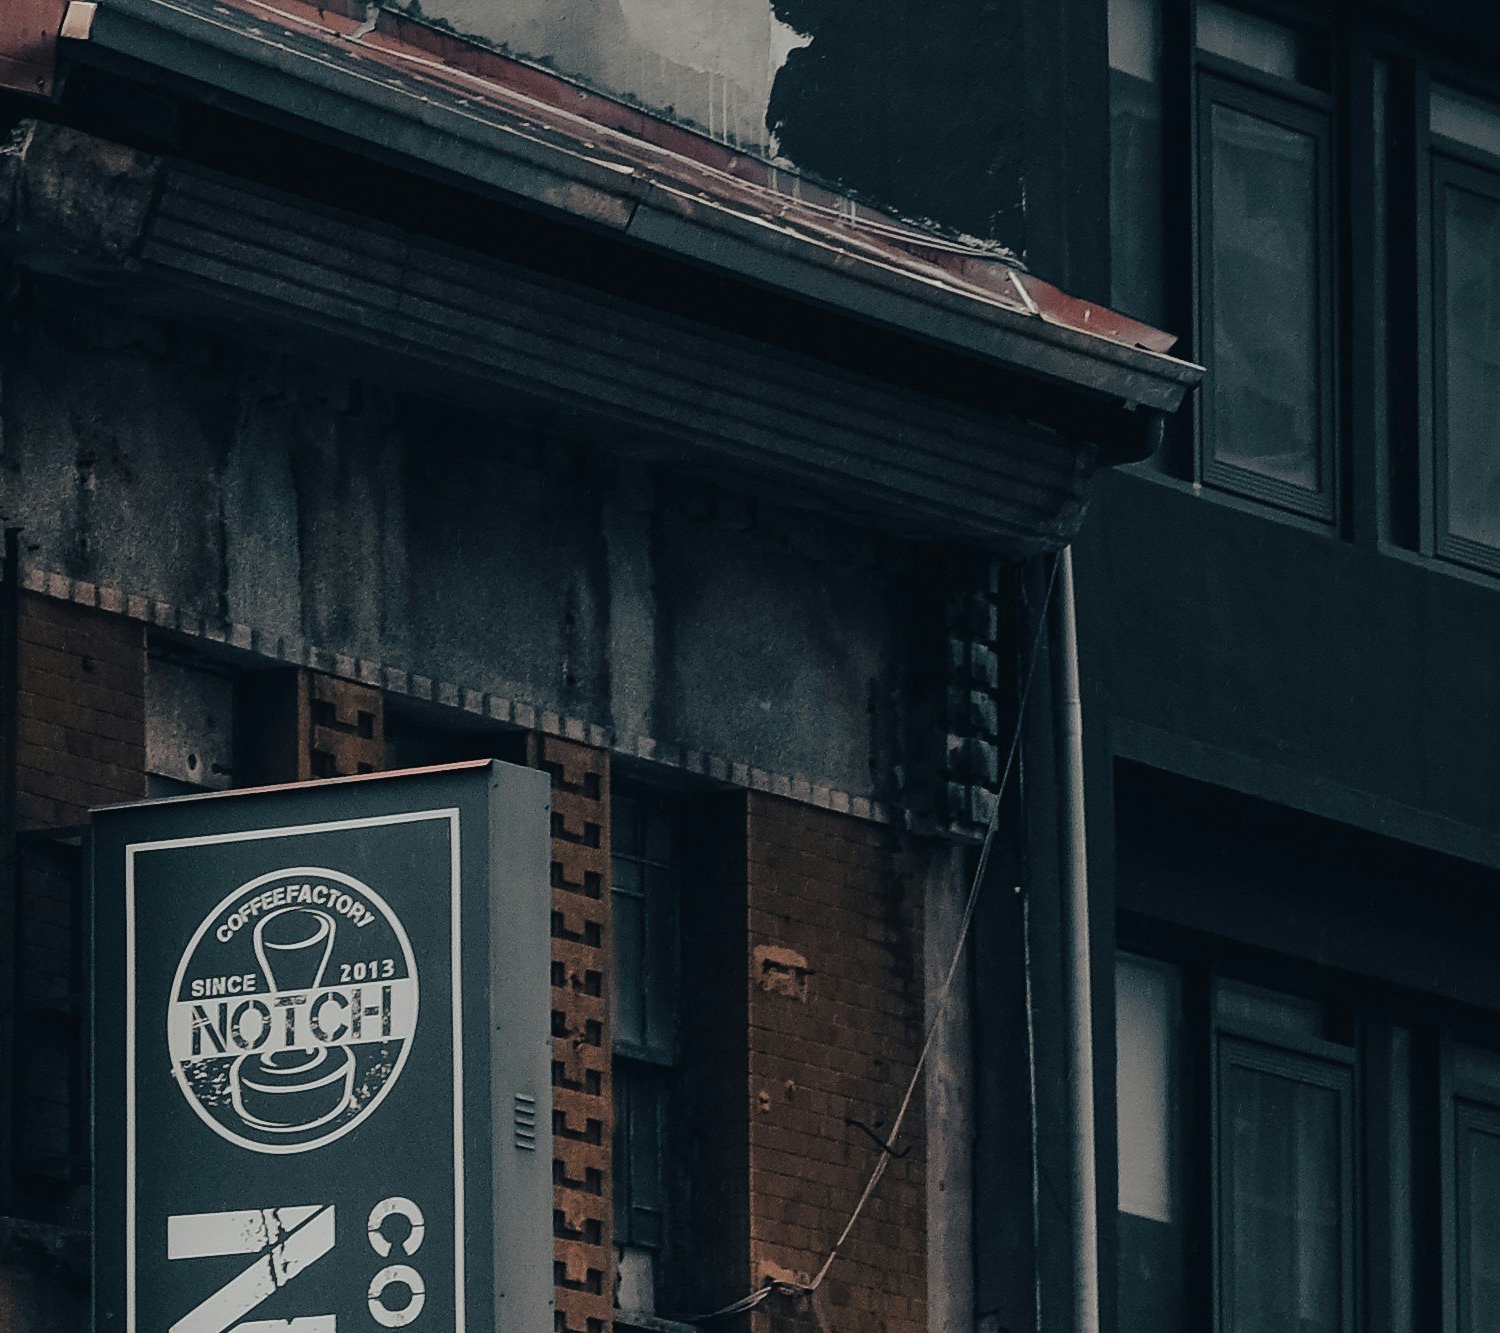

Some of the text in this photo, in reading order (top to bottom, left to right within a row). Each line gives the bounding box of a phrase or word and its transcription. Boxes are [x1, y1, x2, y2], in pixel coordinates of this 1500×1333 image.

[191, 958, 395, 998] SINCE 2013
[190, 985, 392, 1057] NOTCH
